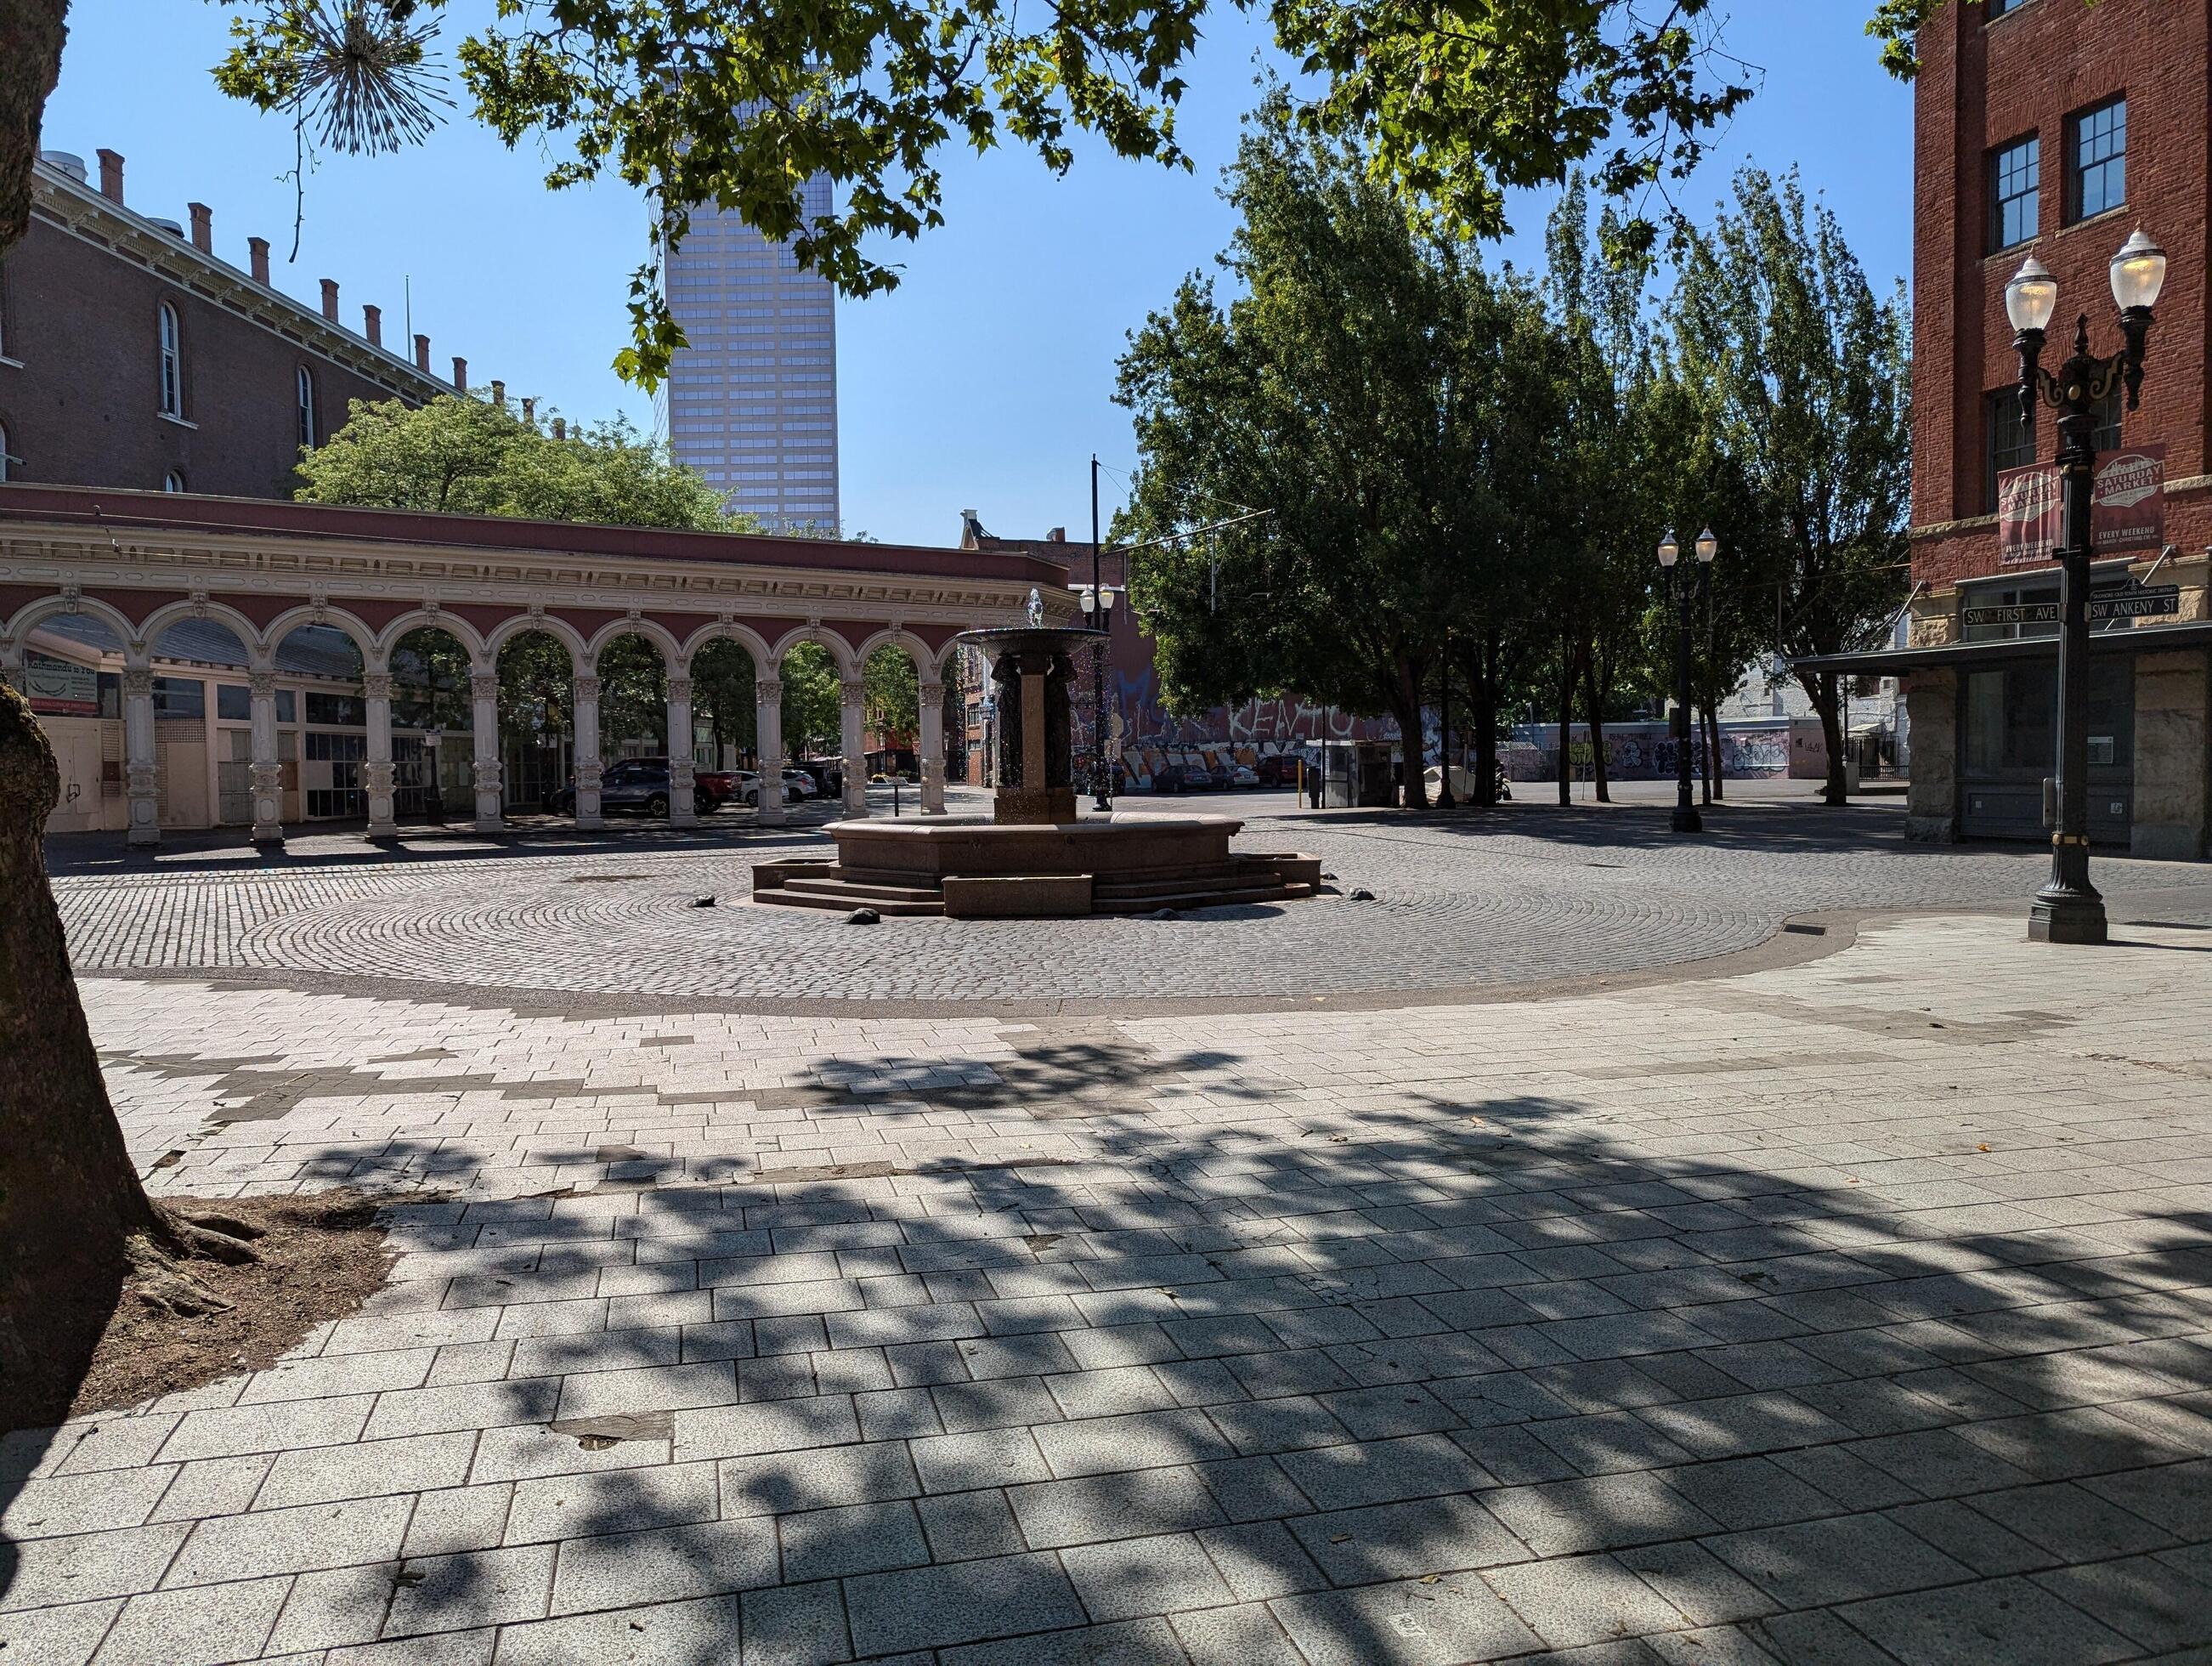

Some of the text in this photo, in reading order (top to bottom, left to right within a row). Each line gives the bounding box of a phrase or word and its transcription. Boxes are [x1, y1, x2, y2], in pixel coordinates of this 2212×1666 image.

[2096, 464, 2161, 489] SATURDAY
[2105, 476, 2153, 495] MARKET
[2001, 480, 2056, 506] SATURDAY
[2008, 491, 2051, 512] MARKET
[2098, 526, 2155, 540] EVERY WEEKEND
[1967, 604, 2056, 624] SW FIRST AVE
[2092, 598, 2176, 618] SW ANKENY ST
